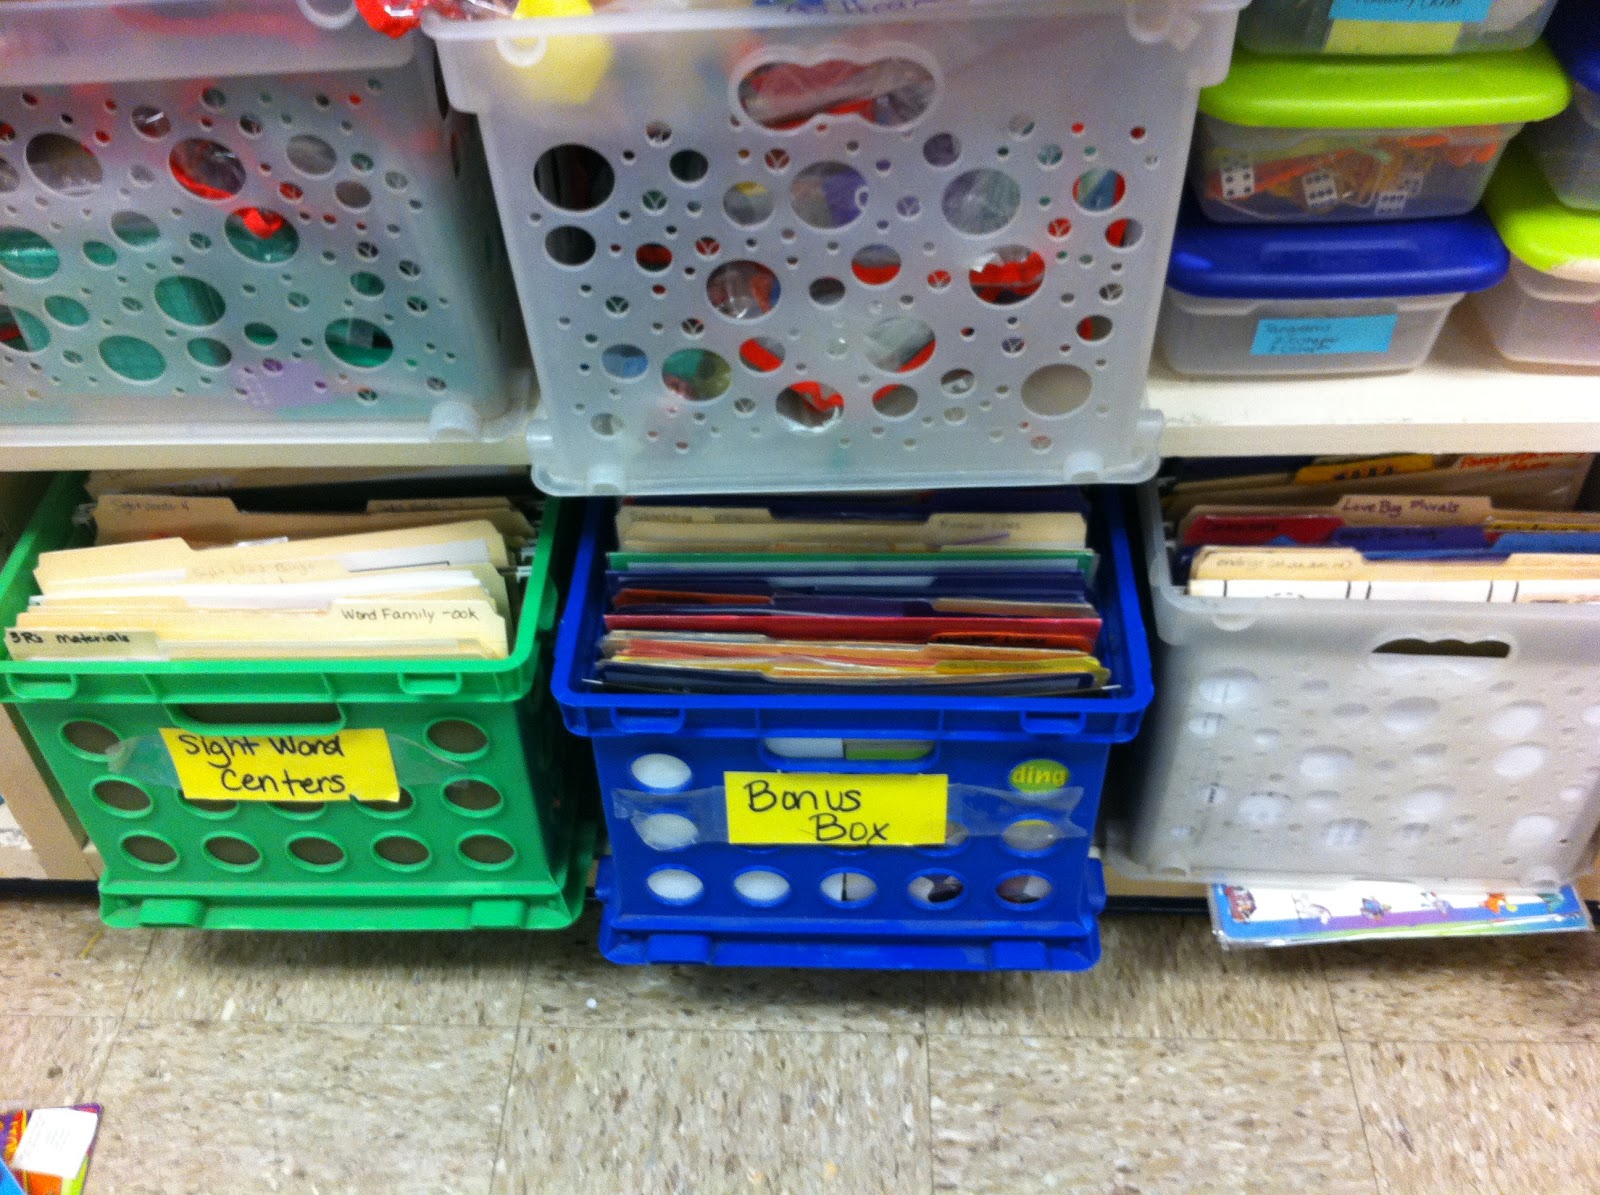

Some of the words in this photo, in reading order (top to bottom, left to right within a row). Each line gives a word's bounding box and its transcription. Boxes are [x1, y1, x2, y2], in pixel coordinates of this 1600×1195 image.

[341, 608, 378, 620] Word
[381, 607, 435, 624] Family
[178, 733, 261, 768] Sight
[268, 735, 345, 757] Word
[221, 768, 346, 796] Centers
[743, 779, 862, 812] Bonus
[808, 812, 890, 846] Box
